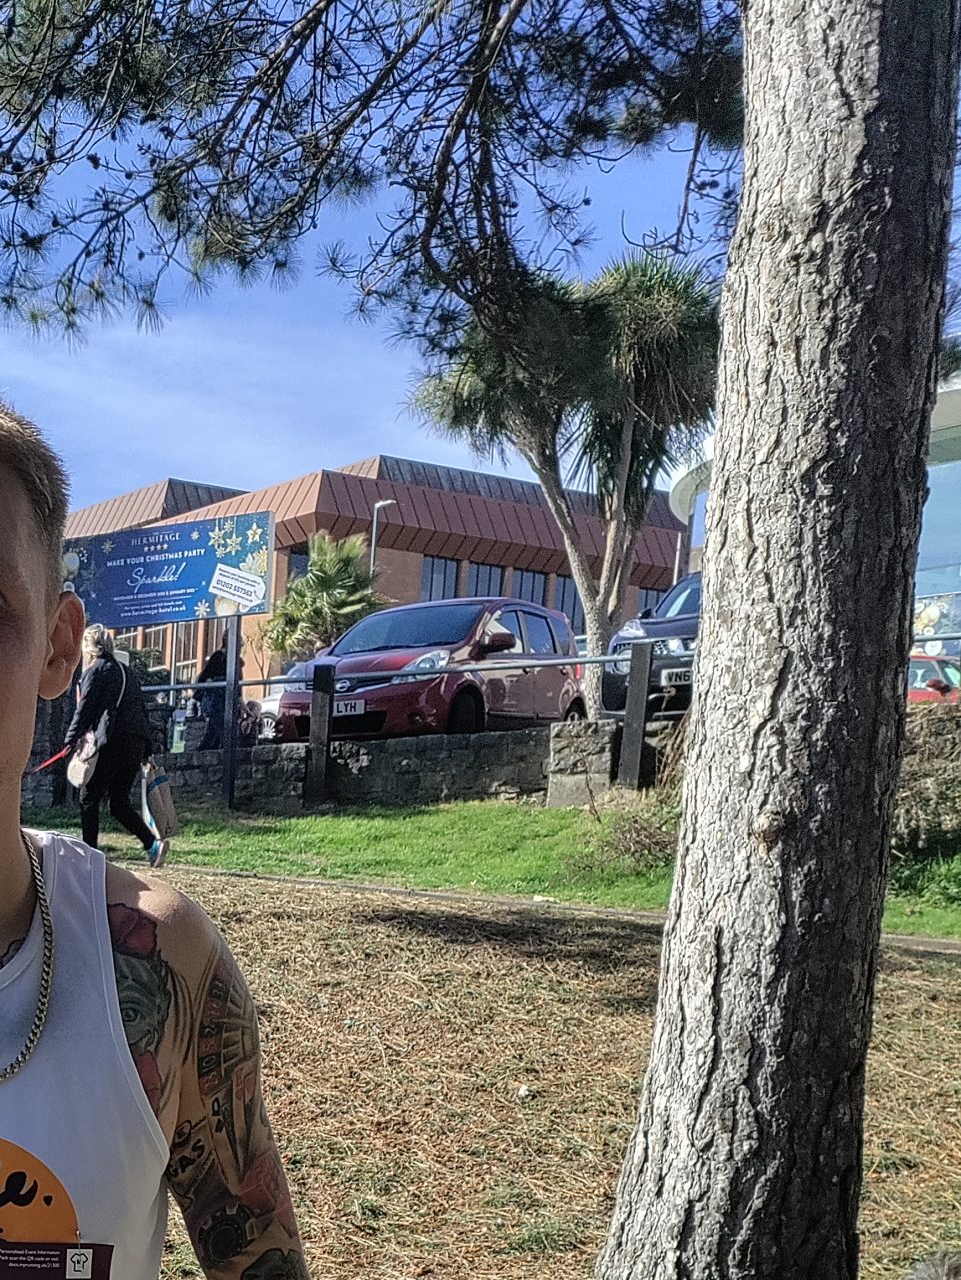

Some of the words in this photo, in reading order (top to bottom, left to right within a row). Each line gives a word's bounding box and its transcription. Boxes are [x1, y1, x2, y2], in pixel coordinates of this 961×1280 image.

[131, 532, 182, 546] HERMITAGE
[127, 557, 145, 565] YOUR
[146, 552, 183, 563] CHRISTMAS
[184, 549, 206, 558] PARTY
[337, 702, 357, 713] LYH
